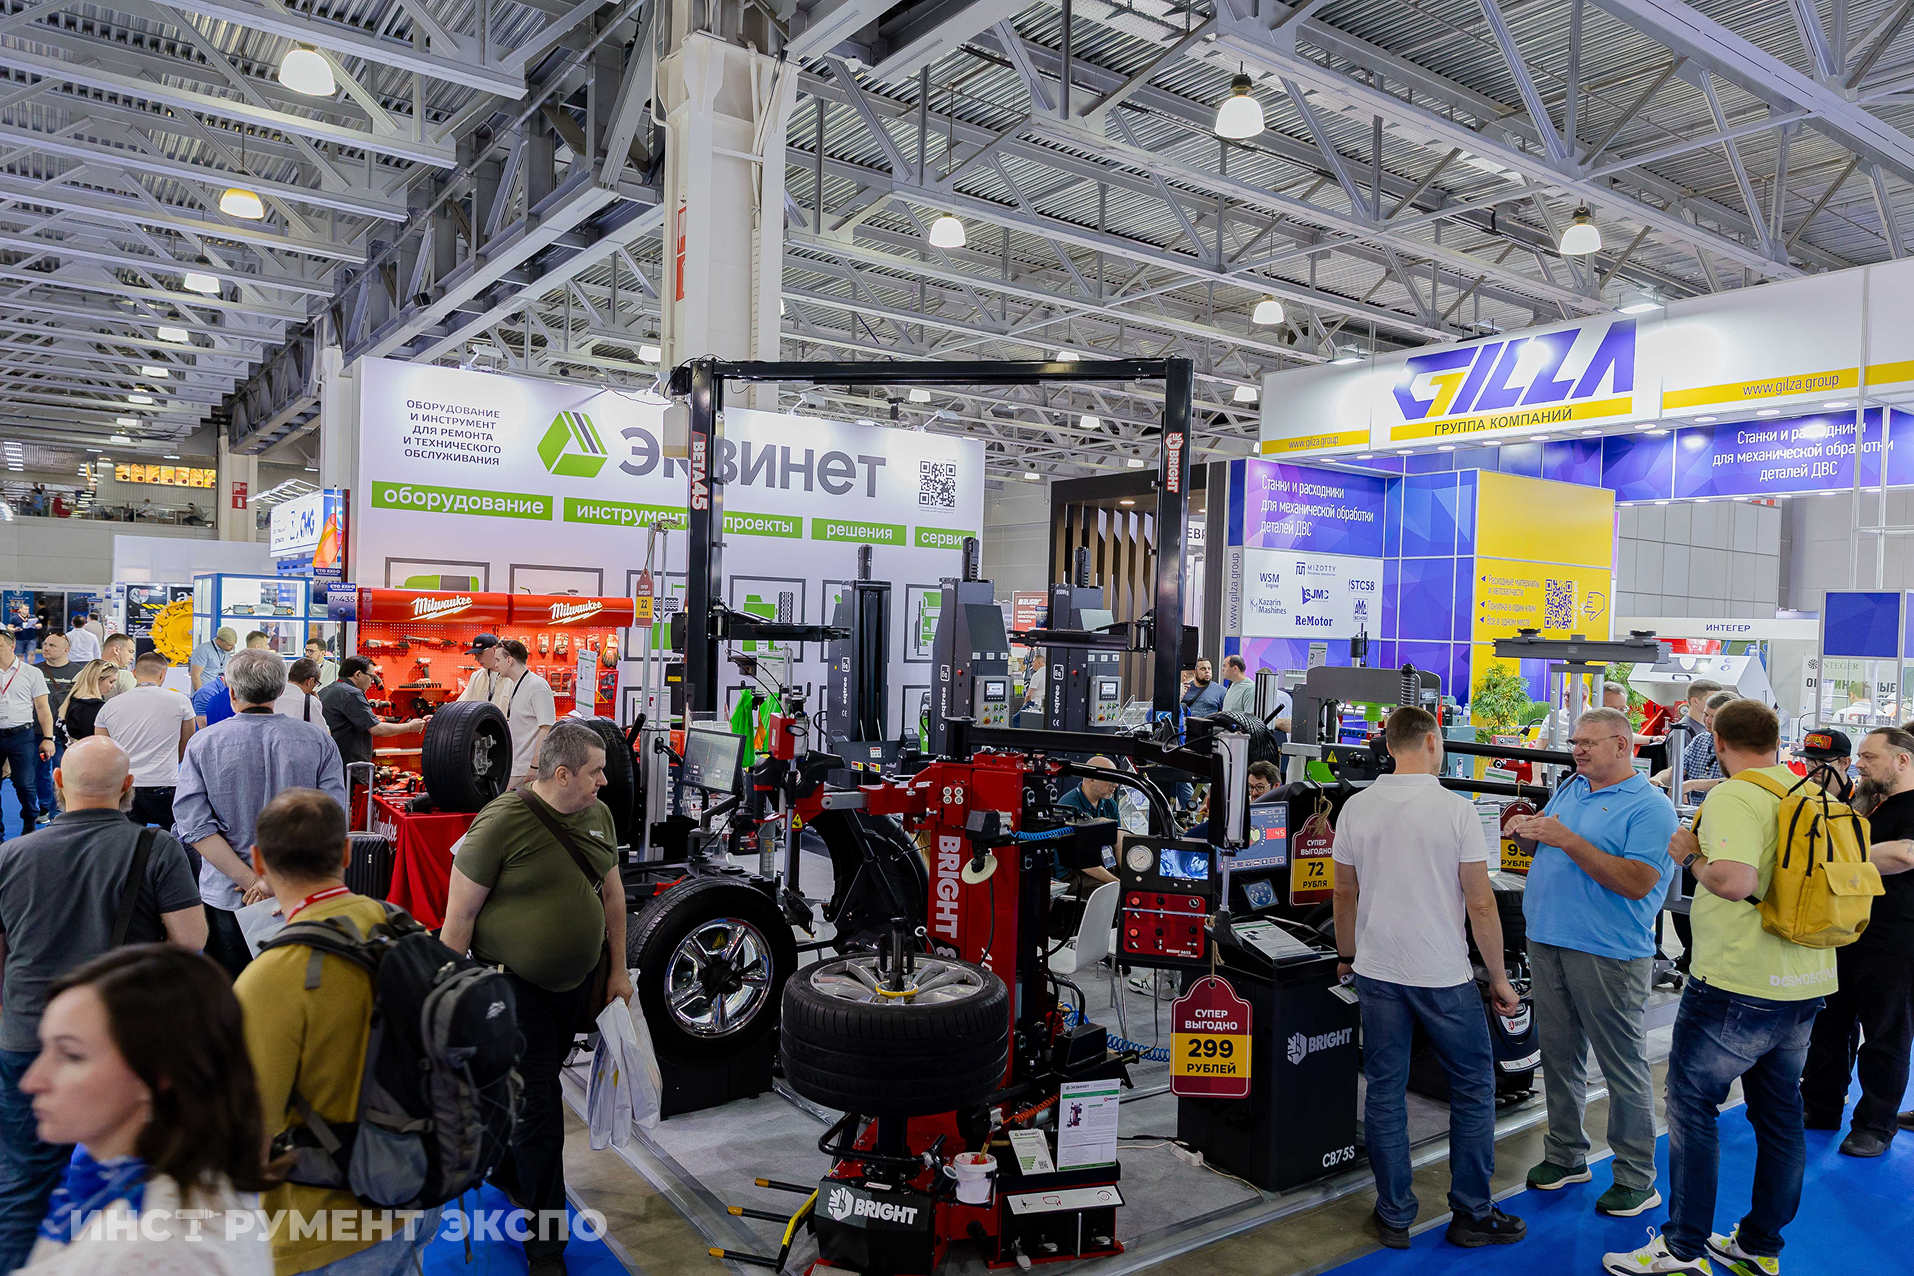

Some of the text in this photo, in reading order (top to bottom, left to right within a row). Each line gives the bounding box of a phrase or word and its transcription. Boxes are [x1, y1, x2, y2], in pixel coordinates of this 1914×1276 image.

[1392, 318, 1637, 421] GILZA
[1742, 375, 1840, 396] www.gilza.group
[406, 399, 500, 419] ОБОРУДОВАНИЕ
[410, 412, 497, 430] И ИНСТРУМЕНТ
[1433, 406, 1573, 436] ГРУППА КОМПАНИЙ
[412, 425, 494, 442] ДЛЯ РЕМОНТА
[1287, 434, 1340, 450] www.gilza.group
[1737, 422, 1867, 445] Станки и радники
[403, 436, 501, 454] И ТЕХНИЧЕСКОГО
[404, 448, 500, 466] ОБСЛУЖИВАНИЯ
[1712, 453, 1734, 467] для
[1736, 443, 1823, 464] механической
[691, 440, 709, 511] BETA45
[1166, 450, 1180, 493] BRIGHT
[1759, 461, 1838, 482] деталей ДВС
[1261, 474, 1345, 499] Станки и расходники
[383, 486, 545, 515] оборудование
[1260, 499, 1374, 523] для механической обработки
[724, 516, 793, 534] проекты
[826, 523, 893, 541] решения
[1260, 520, 1313, 537] деталей ДВС
[1307, 564, 1337, 573] MIZOTTY
[1259, 572, 1280, 584] WSM
[1265, 582, 1279, 590] Engine
[1350, 579, 1376, 592] STC58
[1488, 574, 1540, 589] Расходные материалы
[1228, 552, 1242, 630] www.gilza.group
[1492, 587, 1524, 597] автозапчасти
[410, 595, 473, 616] Milwaukee
[548, 599, 603, 619] Milwaukee
[640, 599, 648, 609] 22
[1257, 605, 1287, 616] Mashines
[1258, 597, 1282, 607] Kazarin
[1487, 600, 1508, 613] Покупка
[1294, 615, 1334, 627] ReMotor
[1705, 622, 1751, 633] ИНТЕГЕР
[1823, 661, 1860, 671] NTEGER
[1274, 829, 1285, 837] 45
[1300, 847, 1332, 856] ВЫГОДНО
[1306, 839, 1327, 847] СУПЕР
[1307, 861, 1325, 877] 72
[1501, 859, 1532, 868] РУБЛЕ
[935, 835, 961, 939] BRIGHT
[1302, 880, 1328, 889] РУБЛЯ
[1194, 1008, 1229, 1019] СУПЕР
[1184, 1020, 1239, 1032] ВЫГОДНО
[1187, 1038, 1235, 1059] 299
[1308, 1028, 1353, 1054] BRIGHT
[1186, 1062, 1236, 1075] РУБЛЕЙ
[1321, 1145, 1356, 1168] CB75S
[853, 1198, 918, 1226] BRIGHT
